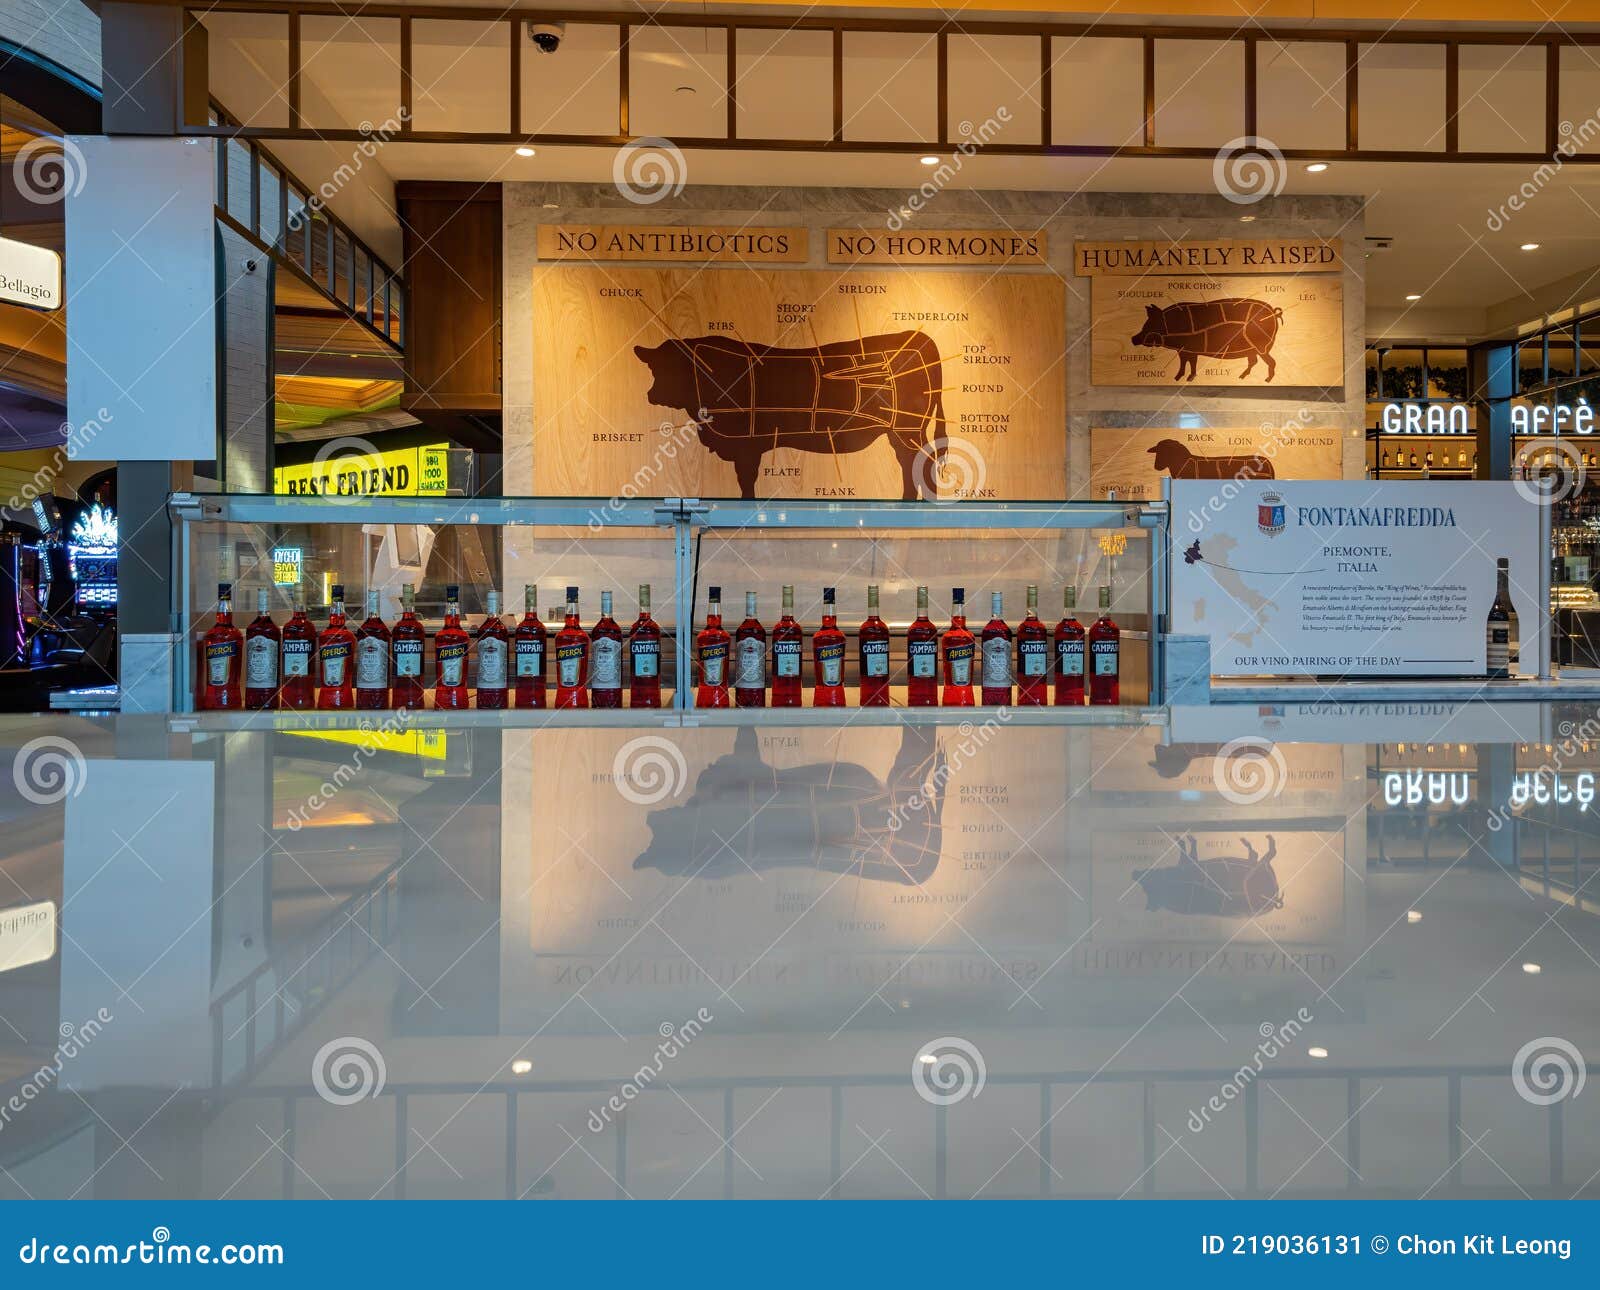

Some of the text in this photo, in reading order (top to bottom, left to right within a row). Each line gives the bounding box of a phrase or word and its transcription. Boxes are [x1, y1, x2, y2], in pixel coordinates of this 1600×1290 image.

[557, 232, 789, 254] NO ANTIBIOTICS
[837, 236, 1039, 256] NO HORMONES
[1082, 246, 1335, 268] HUMANELY RAISED
[838, 285, 887, 294] SIRLOIN
[1168, 282, 1191, 290] PORK
[600, 288, 643, 297] CHUCK
[1118, 290, 1164, 298] SHOULDER
[777, 303, 816, 313] SHORT
[777, 314, 807, 323] LOIN
[893, 312, 969, 321] TENDERLOIN
[708, 322, 735, 331] RIBS
[963, 345, 986, 354] TOP
[963, 355, 1011, 364] SIRLOIN
[1120, 354, 1155, 362] CHEEKS
[1137, 370, 1166, 378] PICNIC
[1205, 368, 1231, 376] BELLY
[962, 384, 1004, 393] ROUND
[960, 414, 1010, 423] BOTTOM
[1383, 398, 1594, 434] GRAN AFFÈ
[960, 425, 1008, 433] SIRLOIN
[593, 433, 644, 442] BRISKET
[1187, 434, 1214, 443] RACK
[1228, 437, 1252, 446] LOIN
[1298, 438, 1334, 446] ROUND
[764, 468, 801, 476] PLATE
[288, 464, 410, 495] BEST FRIEND
[815, 487, 856, 496] FLANK
[954, 489, 996, 498] SHANK
[1298, 507, 1456, 527] FONTANAFREDDA
[1323, 547, 1392, 558] PIEMONTE,
[1337, 562, 1378, 572] ITALIA
[774, 644, 801, 653] CAMPAR
[439, 648, 465, 659] APEROL
[1235, 656, 1401, 666] OUR VINO PAIRING OF THE DAY
